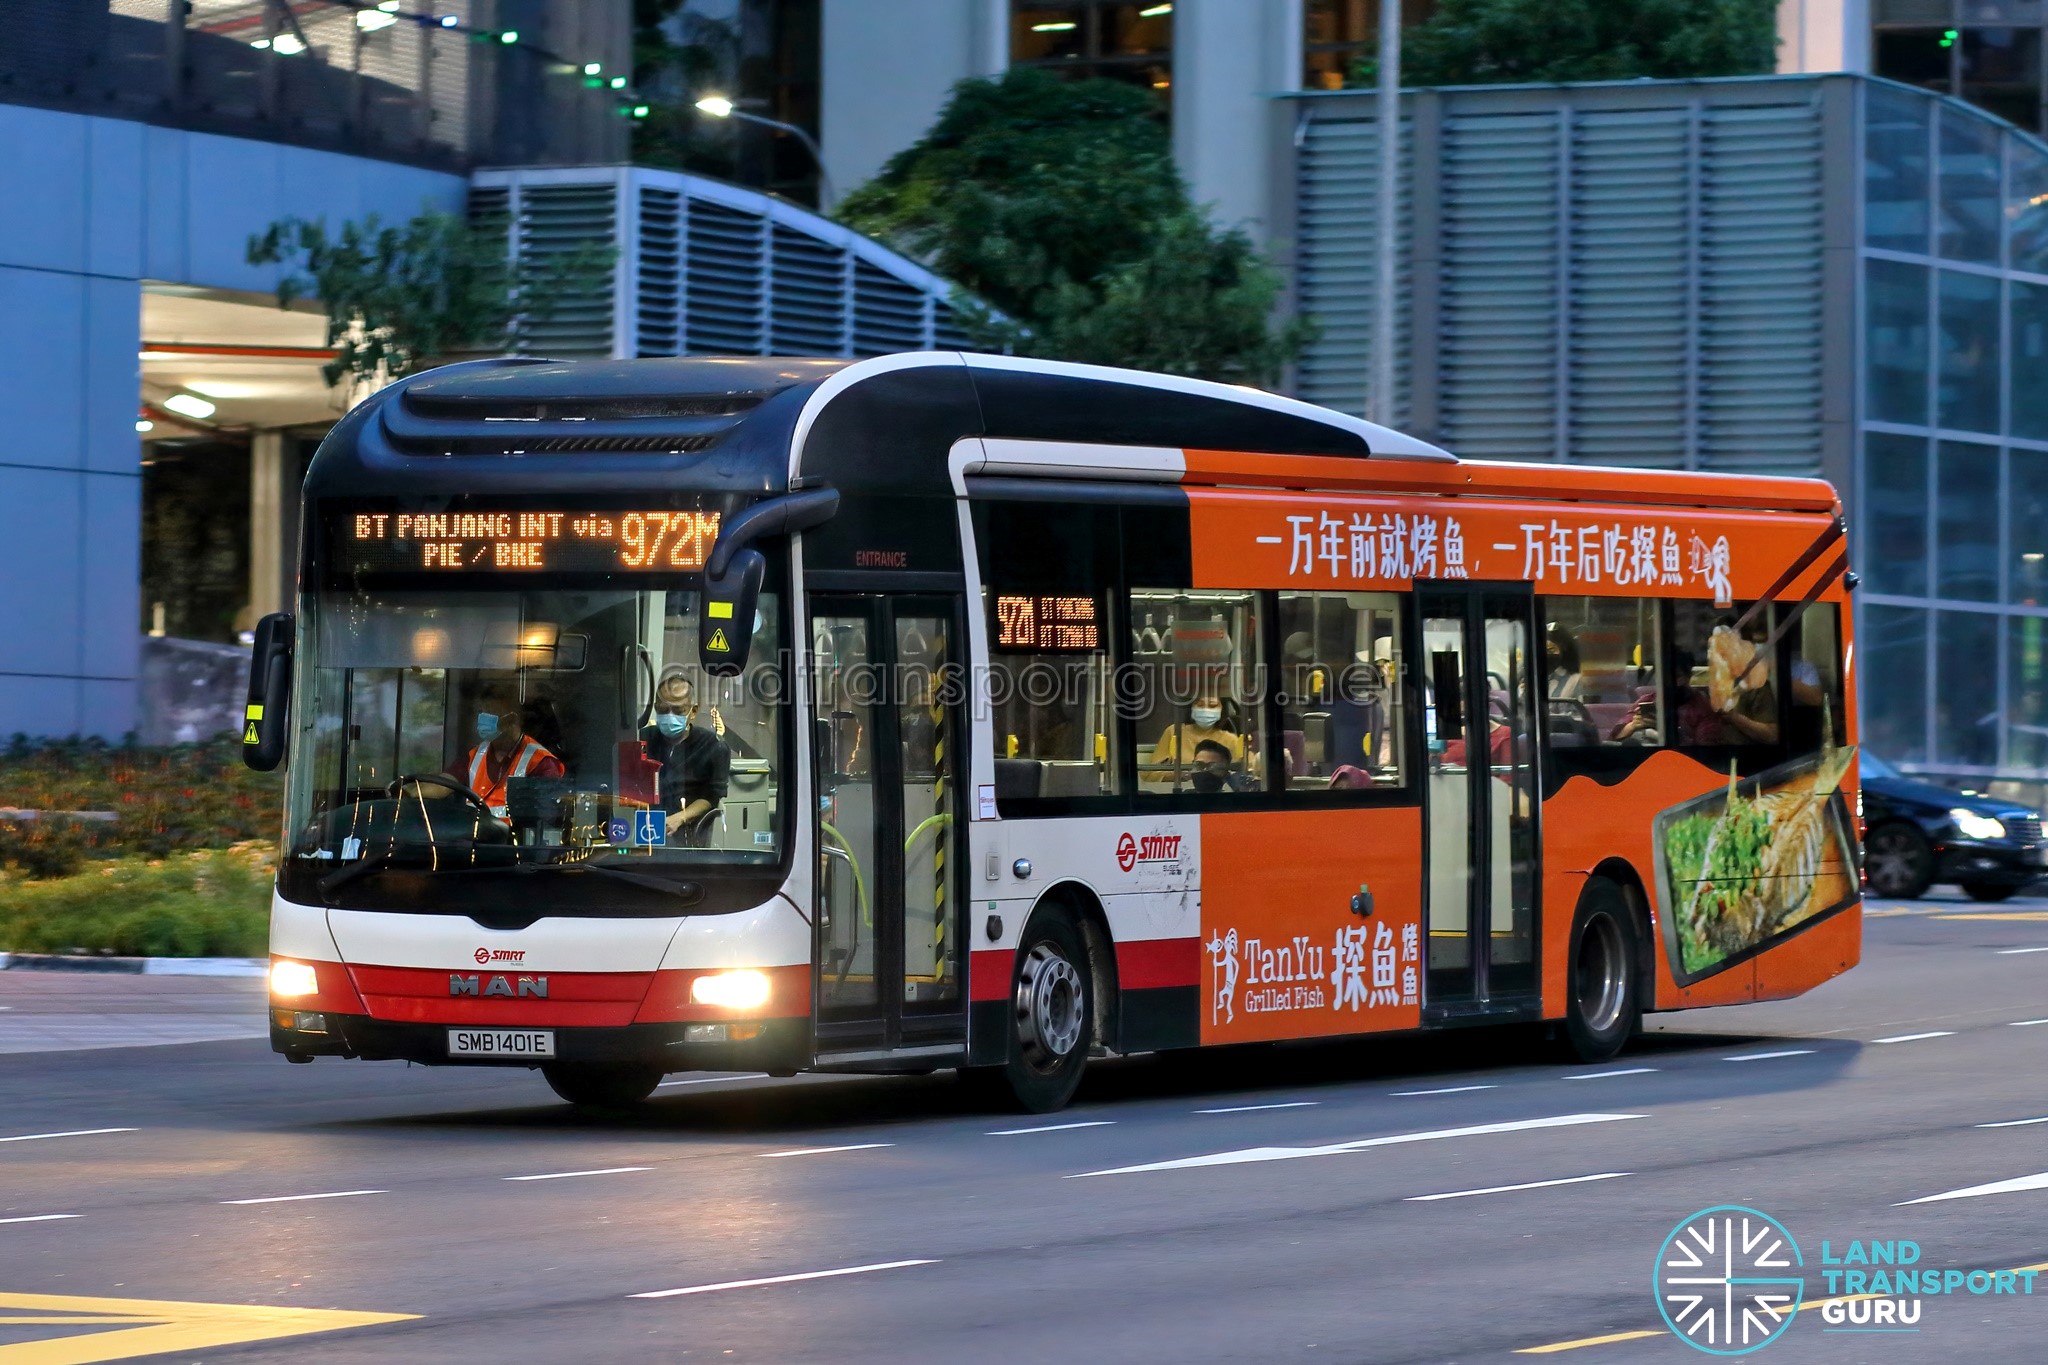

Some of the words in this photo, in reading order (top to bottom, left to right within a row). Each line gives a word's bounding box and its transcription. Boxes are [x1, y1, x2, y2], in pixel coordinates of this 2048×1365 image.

[355, 514, 389, 538] BT
[398, 514, 511, 538] PANJANG
[519, 513, 564, 538] INT
[573, 513, 613, 537] via
[622, 512, 721, 566] 972M
[424, 543, 463, 567] PIE
[472, 545, 488, 564] /
[495, 543, 543, 567] BKE
[856, 550, 907, 568] ENTRANCE
[1138, 835, 1182, 860] SMRT
[490, 950, 526, 961] SMRT
[1244, 936, 1325, 984] TanYu
[1331, 921, 1400, 1012] 探魚
[449, 974, 549, 998] MAN
[1245, 987, 1292, 1013] Grilled
[1293, 985, 1325, 1010] Fish
[457, 1032, 546, 1053] SMB1401E
